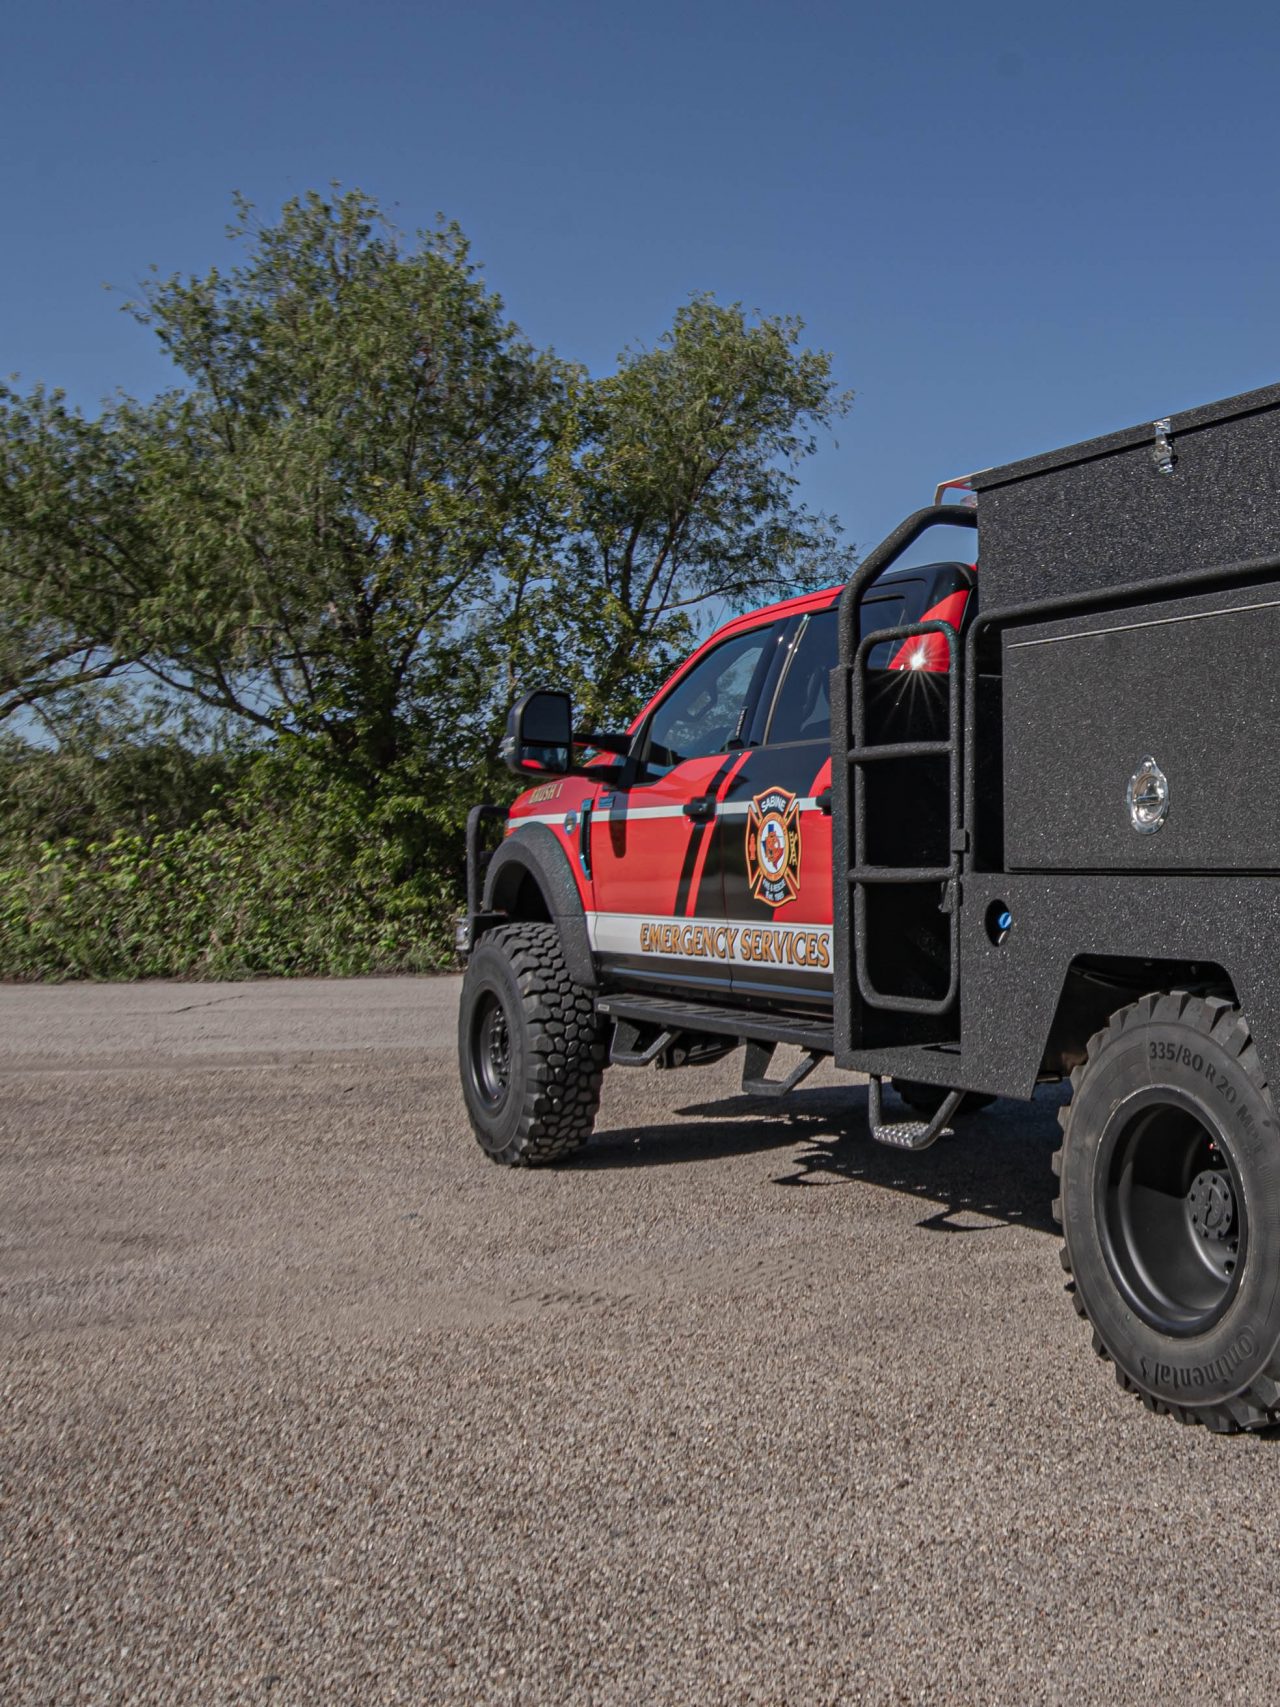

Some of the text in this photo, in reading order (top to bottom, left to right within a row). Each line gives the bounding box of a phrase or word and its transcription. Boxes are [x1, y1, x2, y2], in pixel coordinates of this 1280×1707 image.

[761, 795, 786, 813] SABINE
[640, 923, 830, 968] EMERGENCY SERVICES
[1149, 1041, 1204, 1072] 335/80
[1205, 1063, 1218, 1084] R
[1216, 1075, 1237, 1103] 20
